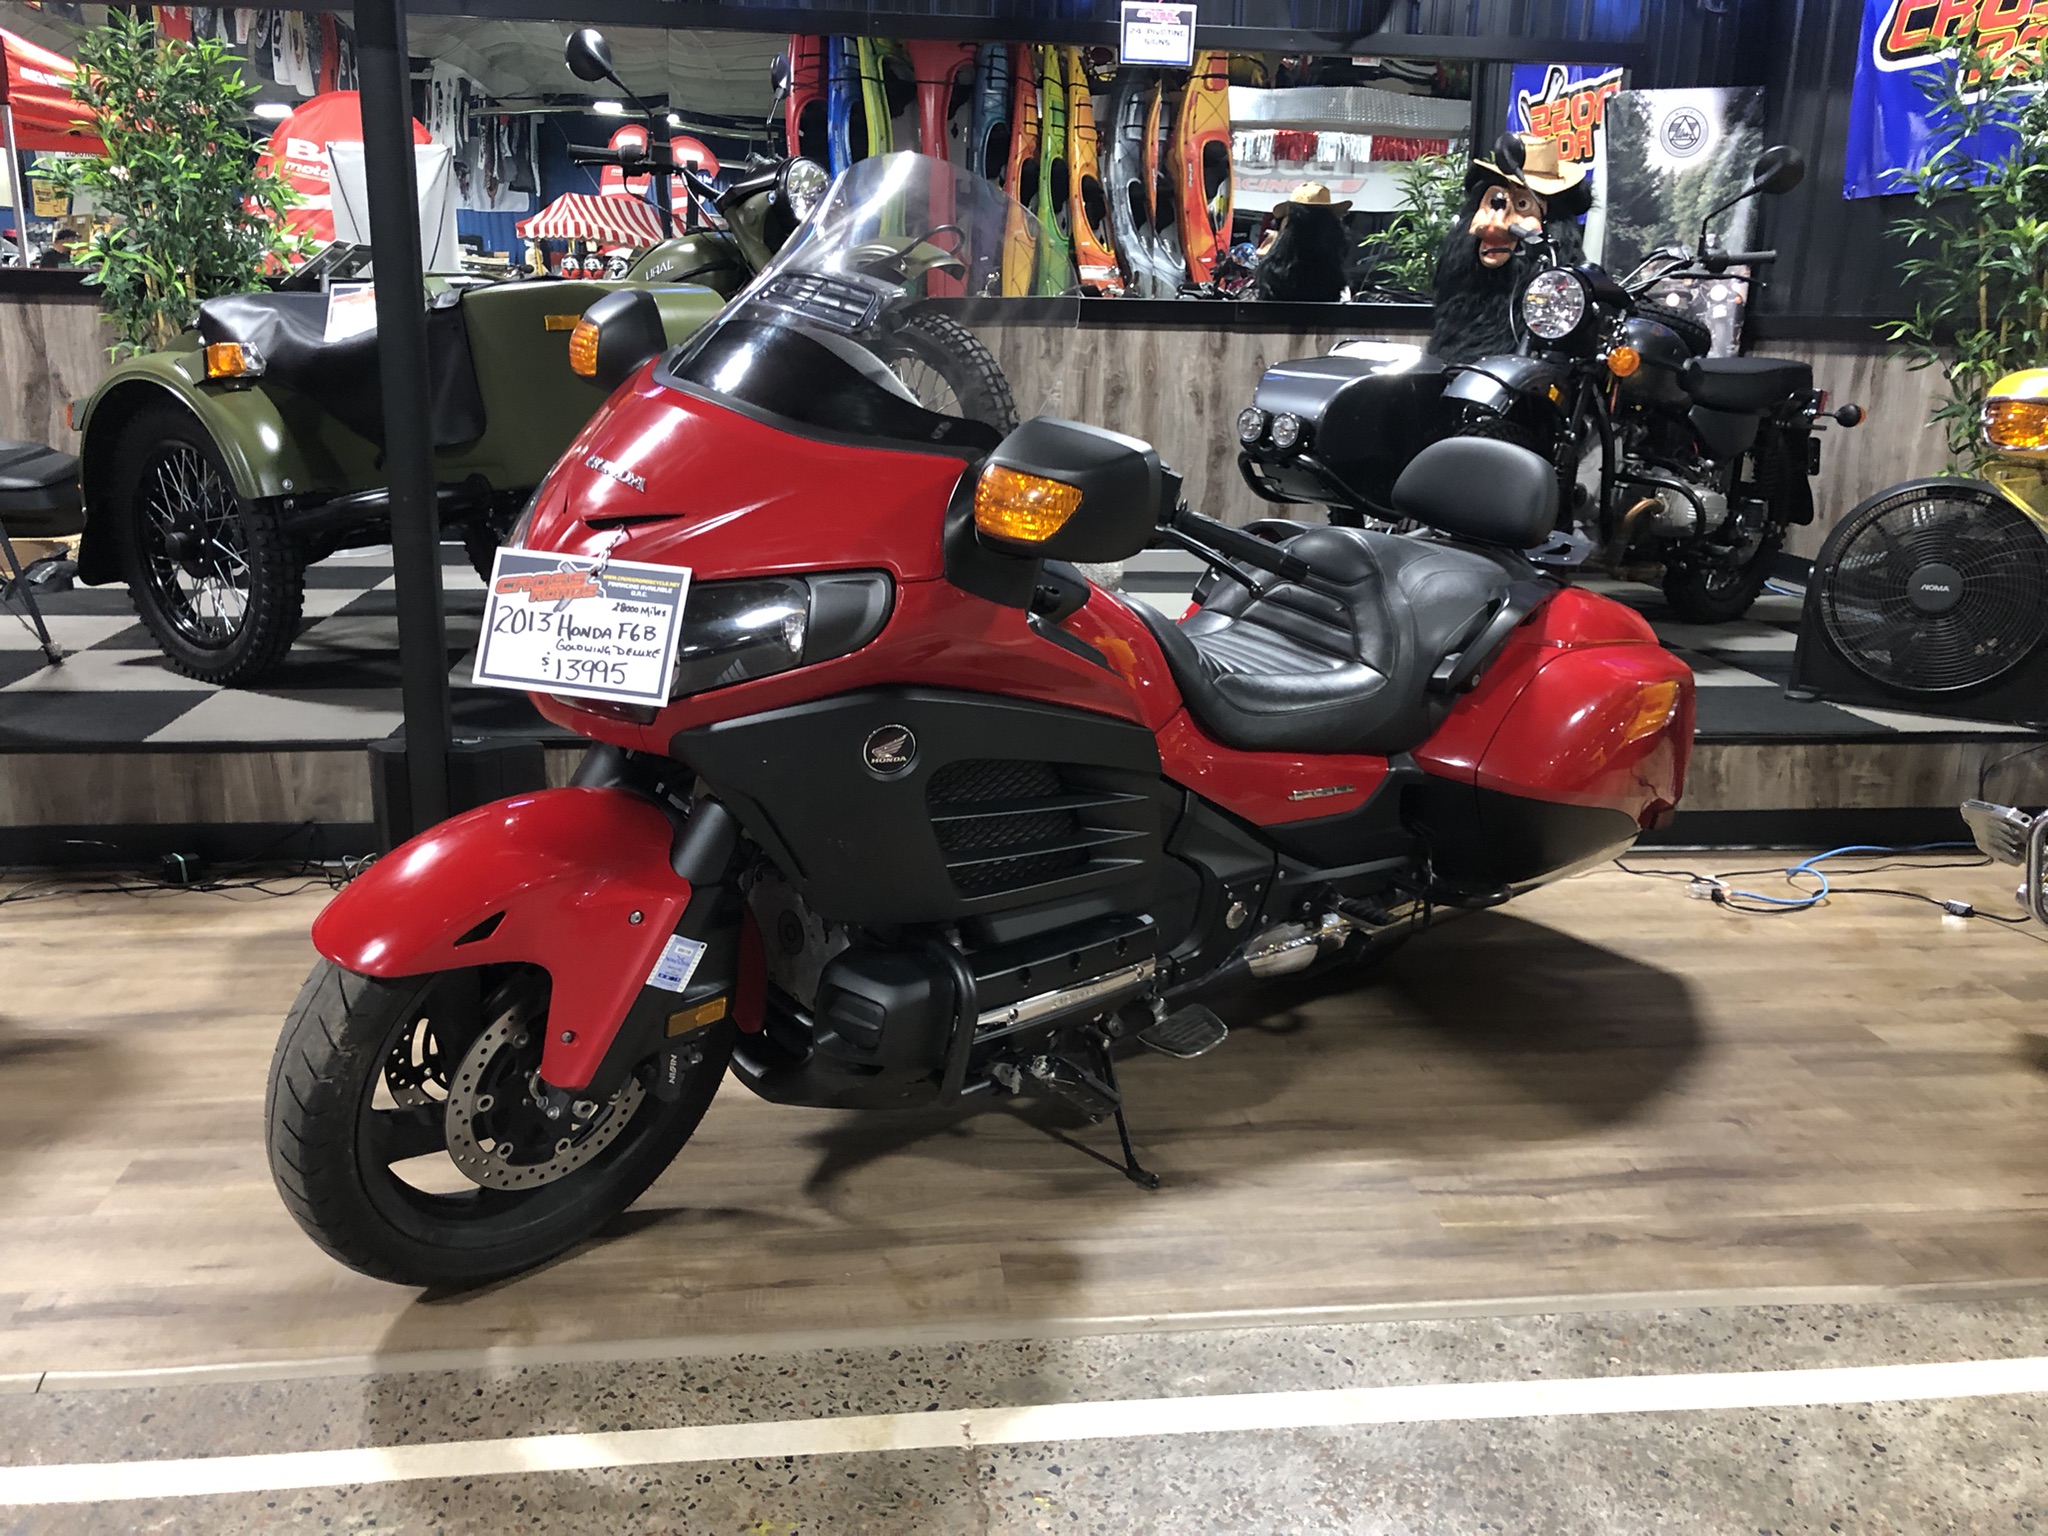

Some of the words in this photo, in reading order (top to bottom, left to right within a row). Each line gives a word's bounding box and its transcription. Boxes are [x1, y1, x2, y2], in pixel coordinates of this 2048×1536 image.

[645, 259, 675, 281] URAL
[495, 570, 588, 595] CROSS
[1920, 583, 1950, 592] NOMA
[528, 583, 599, 603] ROADS
[612, 602, 639, 613] 28000
[640, 606, 667, 618] Miles
[494, 605, 553, 634] 2013
[617, 622, 657, 642] F6B
[871, 756, 907, 764] HONDA
